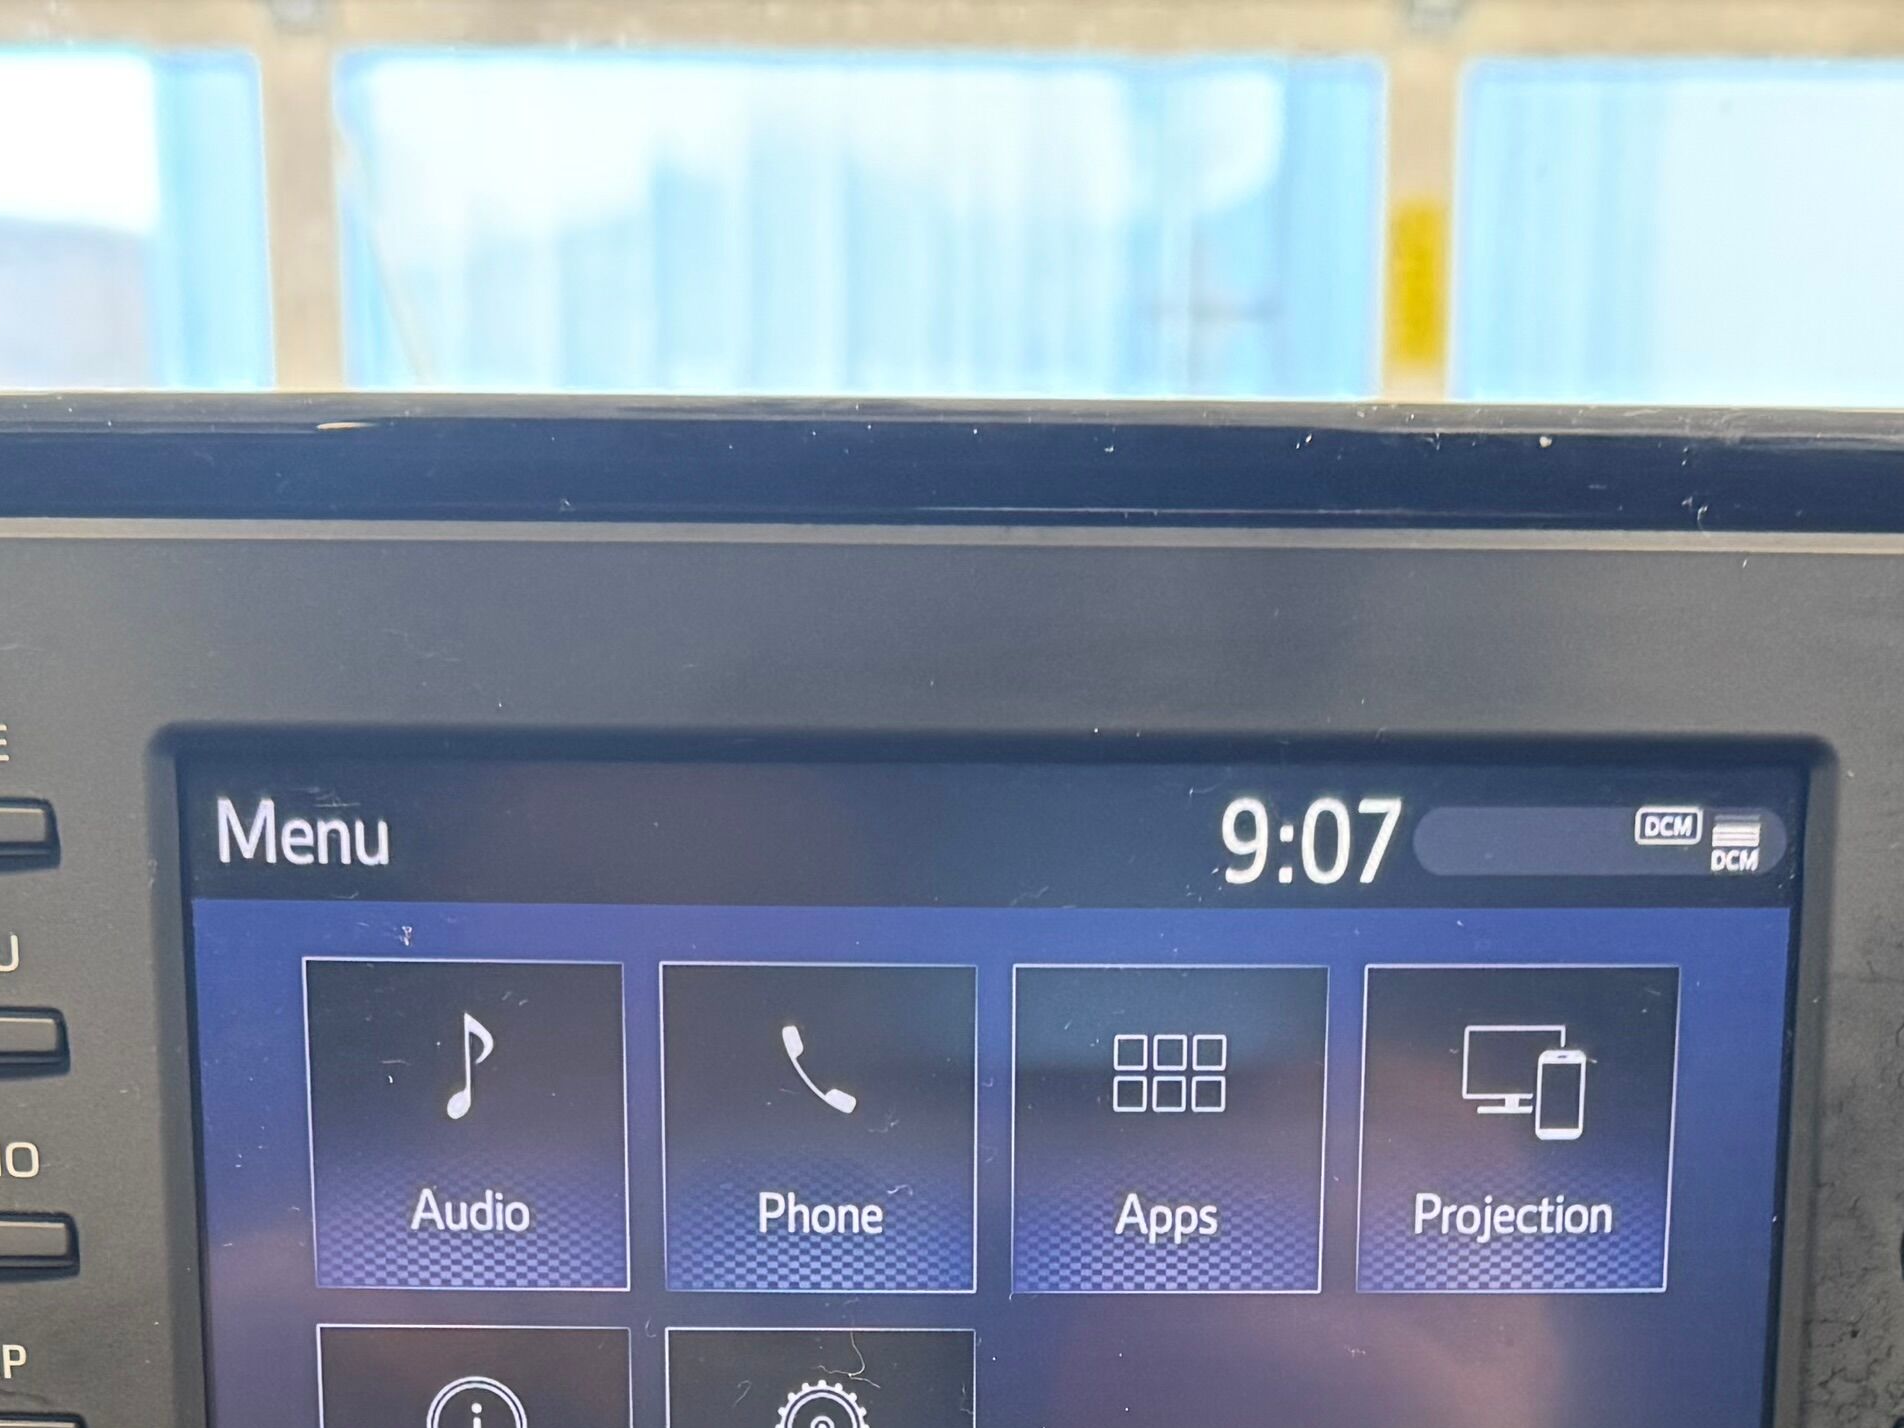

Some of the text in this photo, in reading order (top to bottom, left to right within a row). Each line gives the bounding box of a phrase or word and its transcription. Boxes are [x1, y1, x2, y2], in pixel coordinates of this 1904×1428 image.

[217, 798, 390, 866] Menu
[1221, 797, 1403, 885] 9:07
[1644, 815, 1693, 839] DCM
[1710, 849, 1760, 872] DCM
[410, 1189, 531, 1232] Audio
[758, 1192, 884, 1235] Phone
[1114, 1193, 1218, 1243] Apps
[1413, 1192, 1614, 1243] Projection
